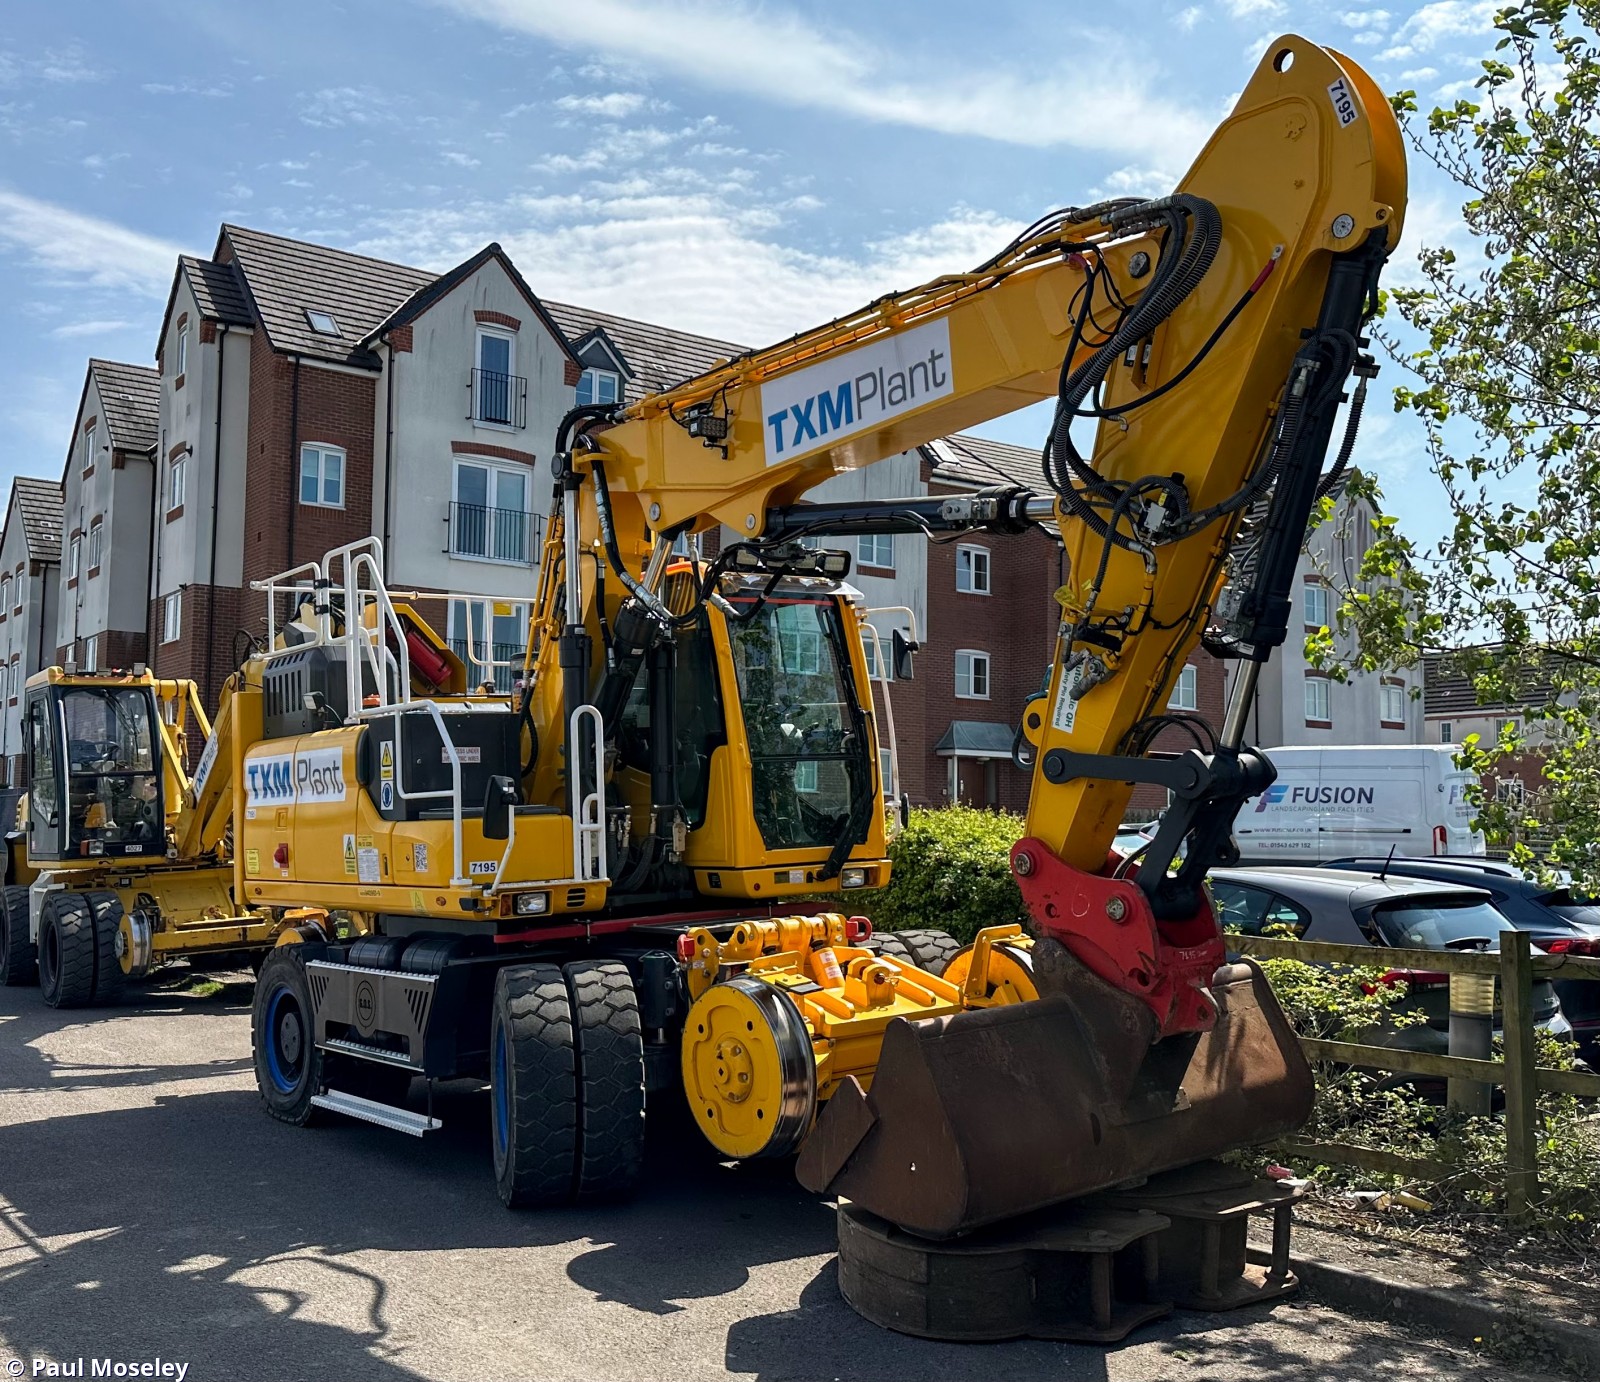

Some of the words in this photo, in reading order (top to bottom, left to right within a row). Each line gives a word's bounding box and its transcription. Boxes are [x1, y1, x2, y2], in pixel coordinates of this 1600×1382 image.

[1331, 80, 1355, 124] 7195
[1065, 712, 1074, 728] QH
[1292, 787, 1374, 804] FUSION
[471, 862, 496, 873] 7195
